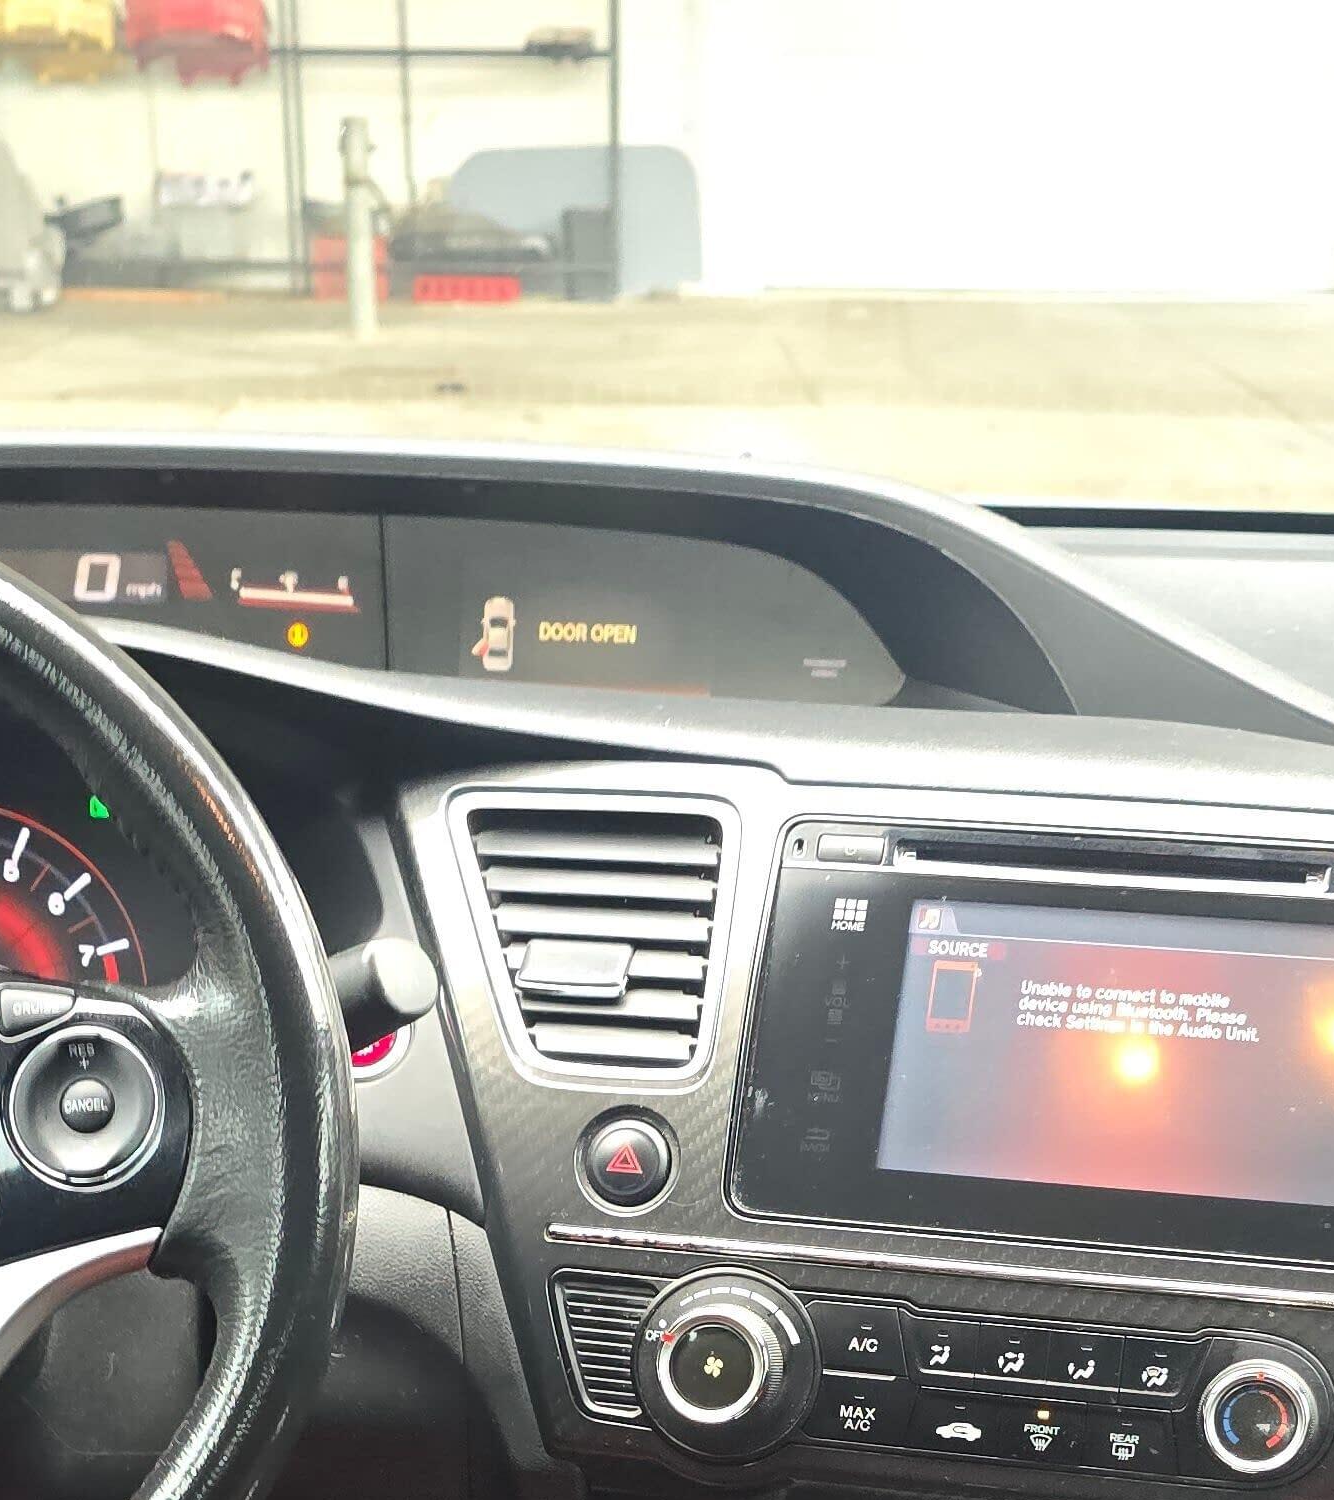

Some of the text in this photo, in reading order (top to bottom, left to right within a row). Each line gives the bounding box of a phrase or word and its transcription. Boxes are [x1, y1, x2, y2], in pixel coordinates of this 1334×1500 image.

[74, 553, 121, 602] 0
[539, 621, 637, 644] DOOR OPEN
[831, 920, 866, 932] HOME
[78, 943, 95, 967] 7
[928, 939, 988, 958] SOURCE
[1020, 979, 1230, 1008] Unable to connect to mobile
[1018, 996, 1068, 1013] device
[1072, 1000, 1113, 1017] using
[1196, 1008, 1247, 1025] Please
[1017, 1012, 1062, 1028] check
[1177, 1022, 1222, 1039] Audio
[1226, 1026, 1260, 1042] Unit.
[64, 1097, 109, 1115] CANCEL
[848, 1336, 879, 1353] A/C
[839, 1404, 876, 1420] MAX
[844, 1418, 871, 1432] A/C
[1023, 1423, 1060, 1436] FRONT
[1109, 1433, 1139, 1445] REAR
